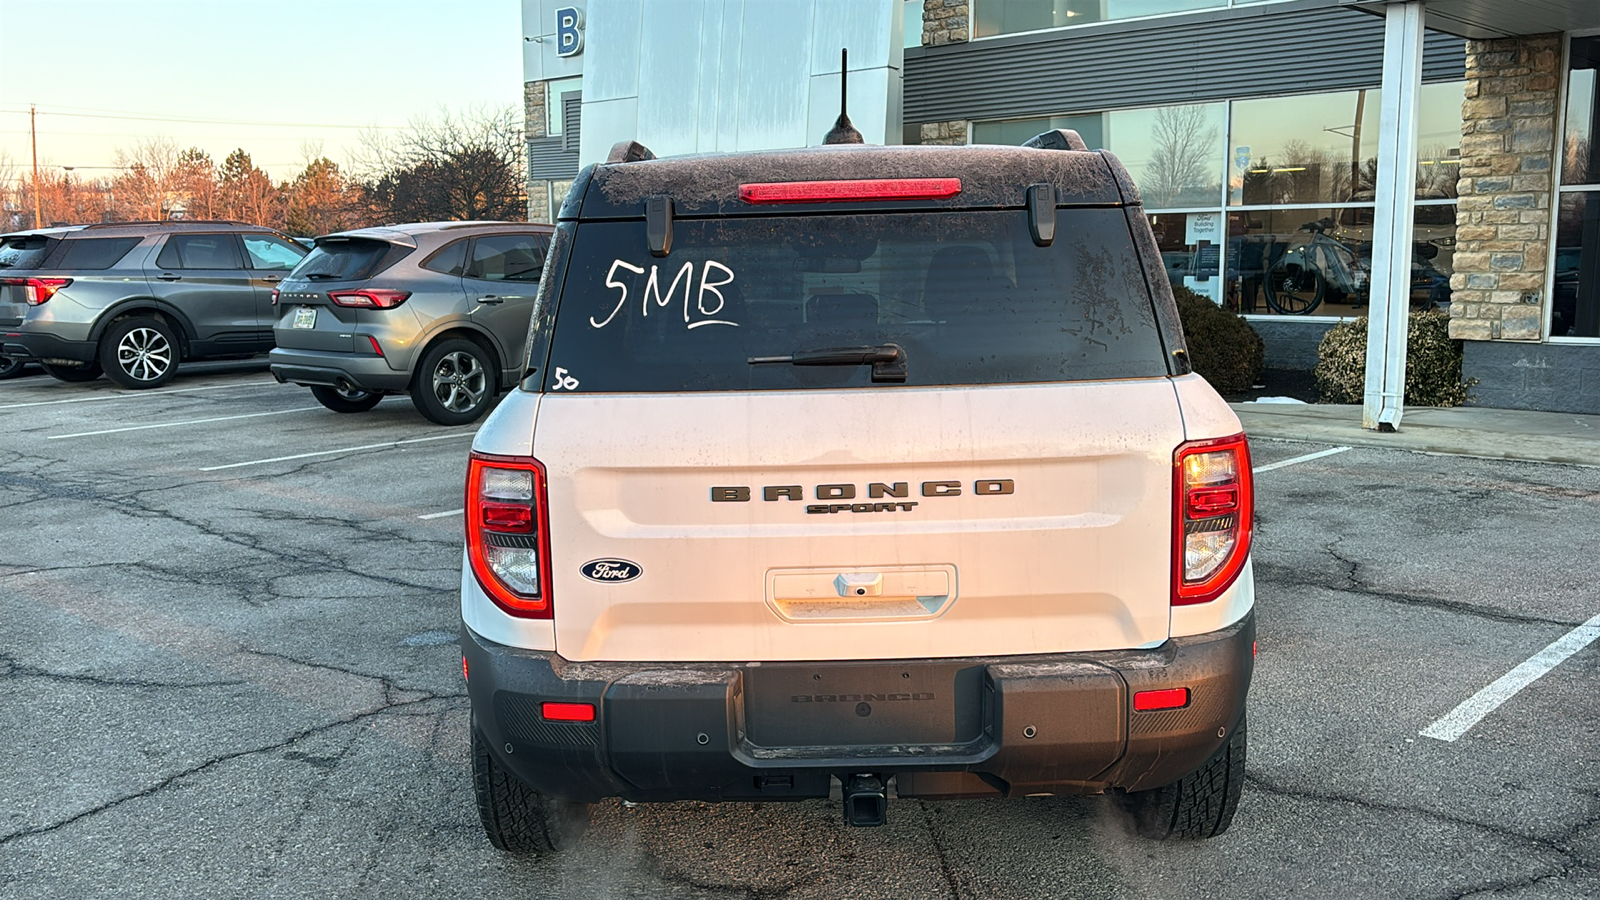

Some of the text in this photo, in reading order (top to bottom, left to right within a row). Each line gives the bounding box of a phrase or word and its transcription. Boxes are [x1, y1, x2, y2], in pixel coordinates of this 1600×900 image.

[710, 478, 1015, 502] BRONCO
[806, 501, 918, 514] SPORT
[591, 562, 631, 578] Ford
[791, 692, 935, 703] BRONCO
